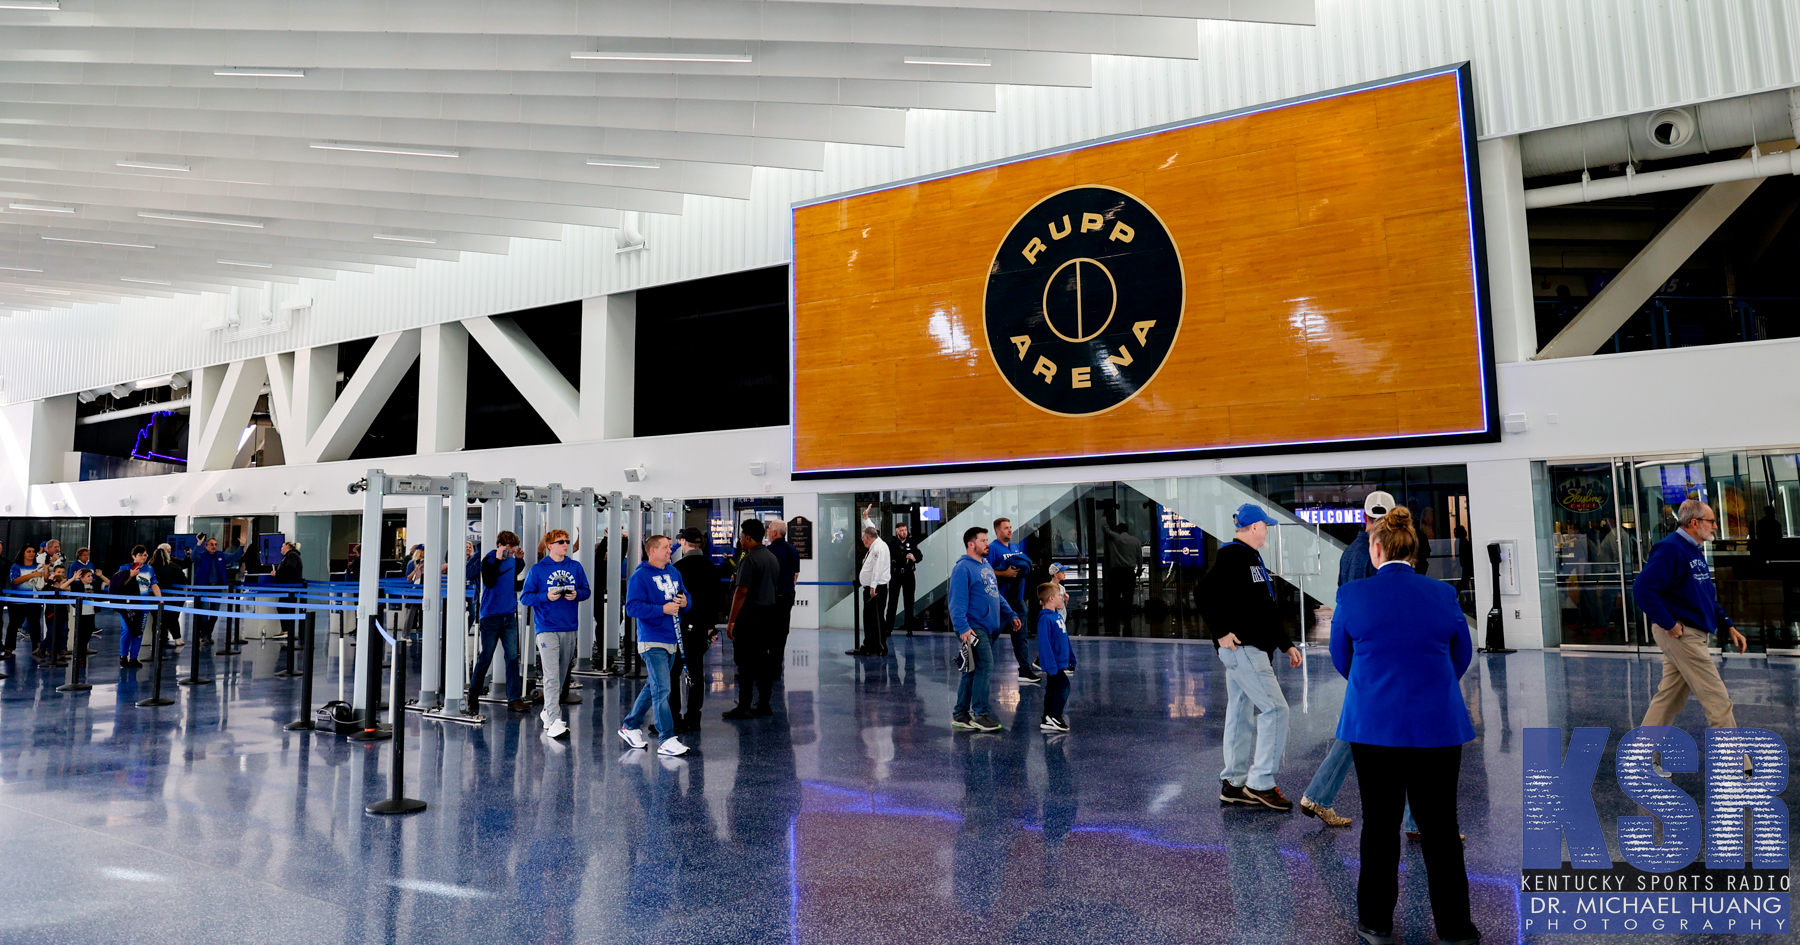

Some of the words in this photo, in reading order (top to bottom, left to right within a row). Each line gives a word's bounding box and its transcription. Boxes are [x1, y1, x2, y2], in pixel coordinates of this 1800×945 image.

[1022, 212, 1135, 265] RUPP
[1010, 319, 1157, 389] ARENA
[1563, 488, 1604, 504] Skyline
[1161, 514, 1172, 522] your
[1300, 509, 1361, 524] WELCOME
[1163, 521, 1175, 529] after
[1178, 528, 1191, 536] floor.
[546, 569, 576, 585] KENTUCKY
